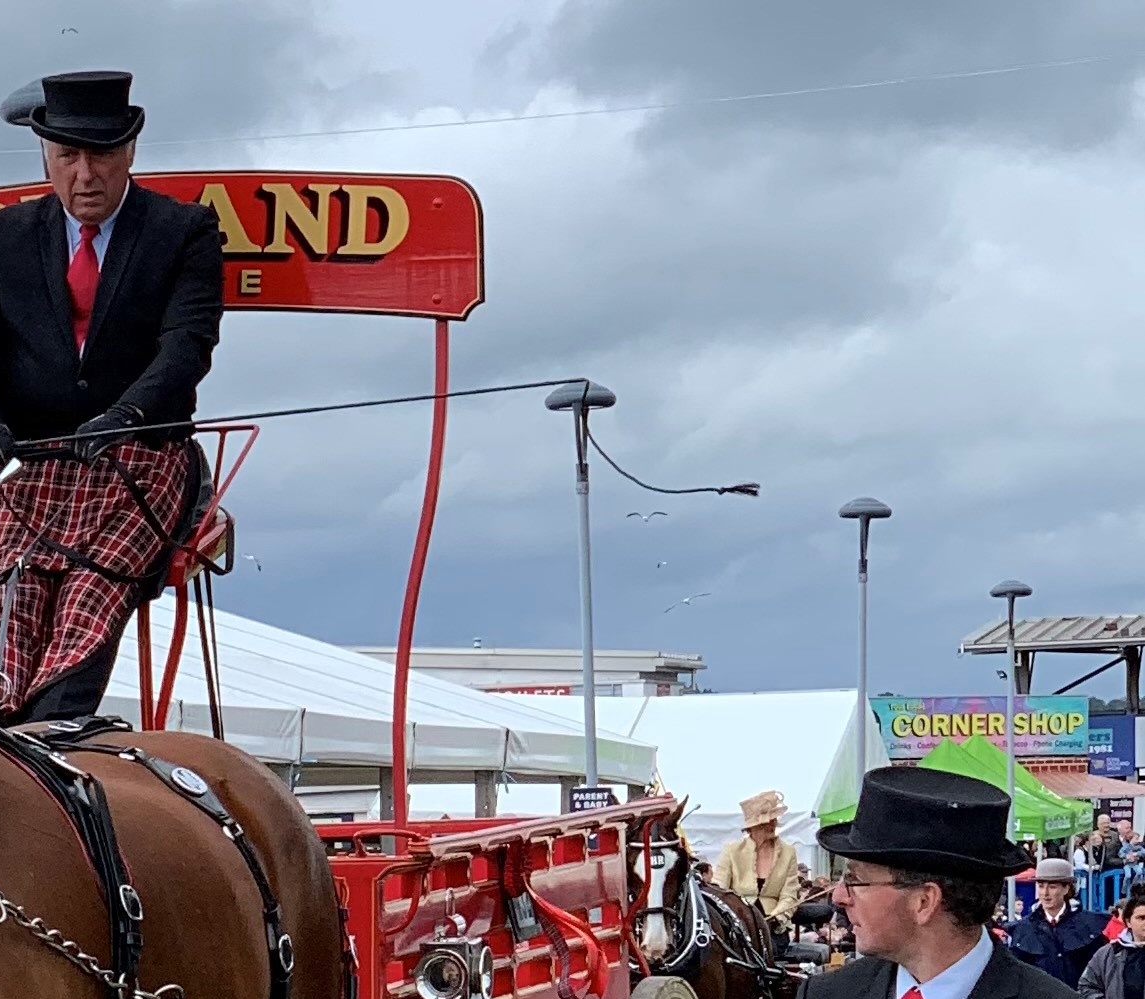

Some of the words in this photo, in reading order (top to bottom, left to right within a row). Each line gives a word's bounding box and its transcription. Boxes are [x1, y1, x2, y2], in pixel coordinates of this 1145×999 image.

[892, 713, 1005, 737] CORNER
[1013, 712, 1084, 736] SHOP
[572, 792, 609, 800] PARENT
